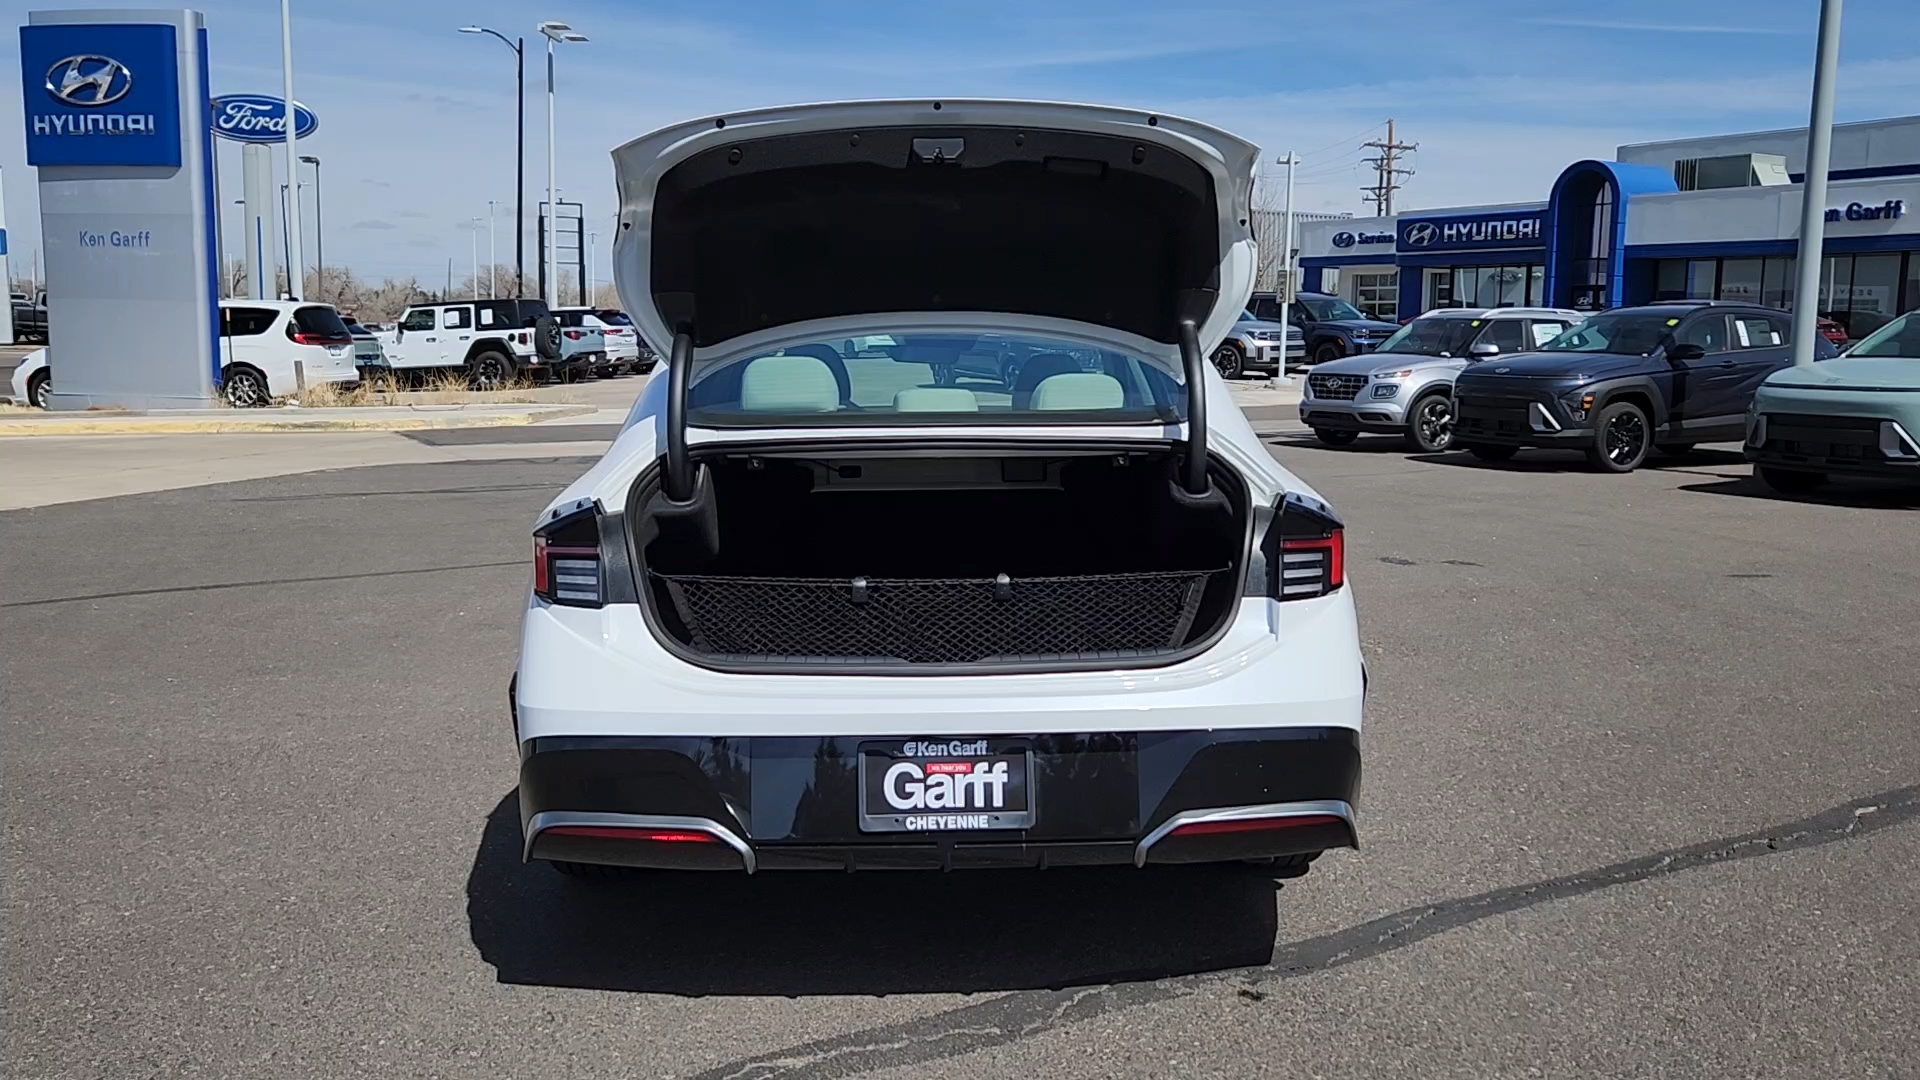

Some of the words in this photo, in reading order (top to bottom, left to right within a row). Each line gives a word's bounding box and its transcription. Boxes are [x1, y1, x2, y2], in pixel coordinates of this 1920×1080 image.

[33, 114, 155, 136] HYUNDAI
[218, 102, 287, 132] Ford
[1845, 200, 1904, 221] Garff
[79, 230, 105, 248] Ken
[110, 230, 150, 248] Garff
[1443, 218, 1541, 243] HYUNDAI
[917, 741, 948, 756] Ken
[949, 740, 988, 756] Garff
[941, 763, 955, 771] hear
[955, 764, 967, 773] you
[883, 761, 1008, 810] Garff
[905, 815, 989, 830] CHEYENNE
